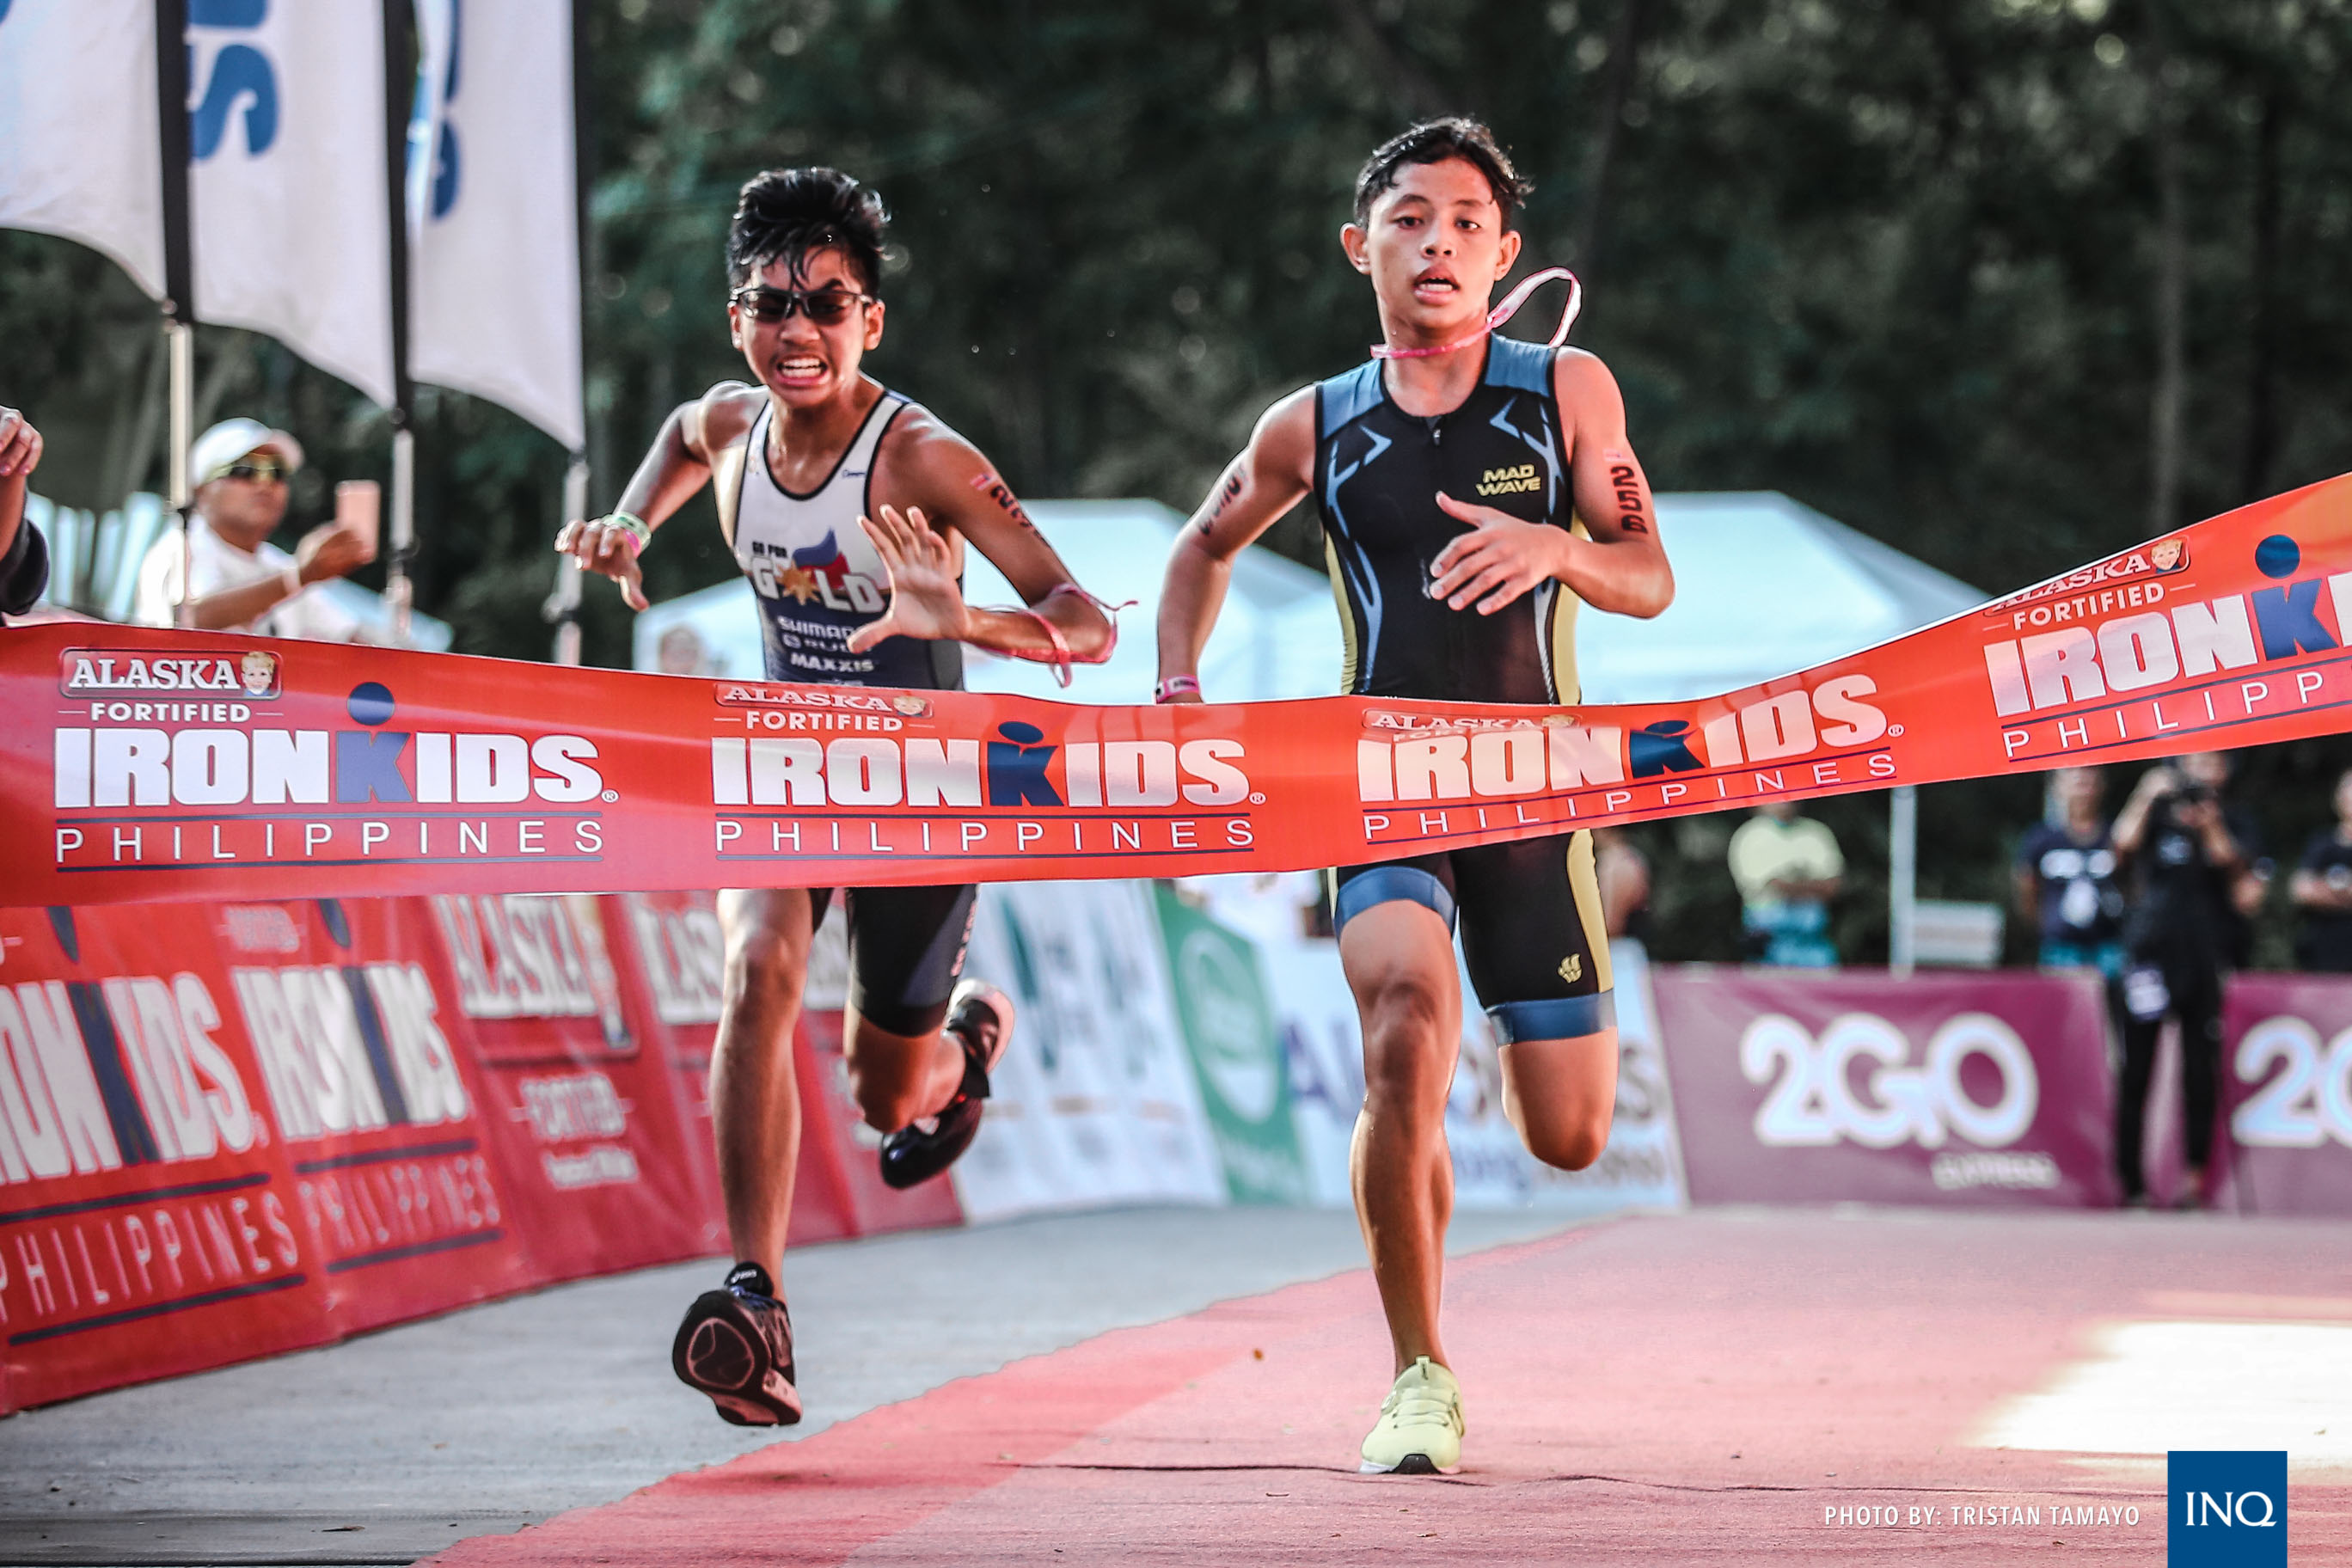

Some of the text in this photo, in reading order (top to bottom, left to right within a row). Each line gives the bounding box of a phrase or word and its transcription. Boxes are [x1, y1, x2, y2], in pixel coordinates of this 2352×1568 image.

[1475, 475, 1541, 497] WAVE
[1483, 463, 1534, 483] MAD
[2012, 582, 2165, 630] FORTIFIED
[68, 658, 241, 690] ALASKA
[790, 652, 874, 672] MAXXIS
[90, 702, 252, 723] FORTIFIED
[724, 684, 892, 712] ALASKA
[746, 710, 903, 732] FORTIFIED
[1371, 714, 1534, 731] ALASKA
[1357, 673, 1890, 802] IRONKIDS
[54, 727, 604, 808] IRONKIDS
[712, 736, 1251, 808] IRONKIDS
[1363, 753, 1897, 839] PHILIPPINES
[56, 819, 604, 863] PHILIPPINES
[714, 819, 1255, 852] PHILIPPINES
[1738, 1011, 2040, 1148] 2GO
